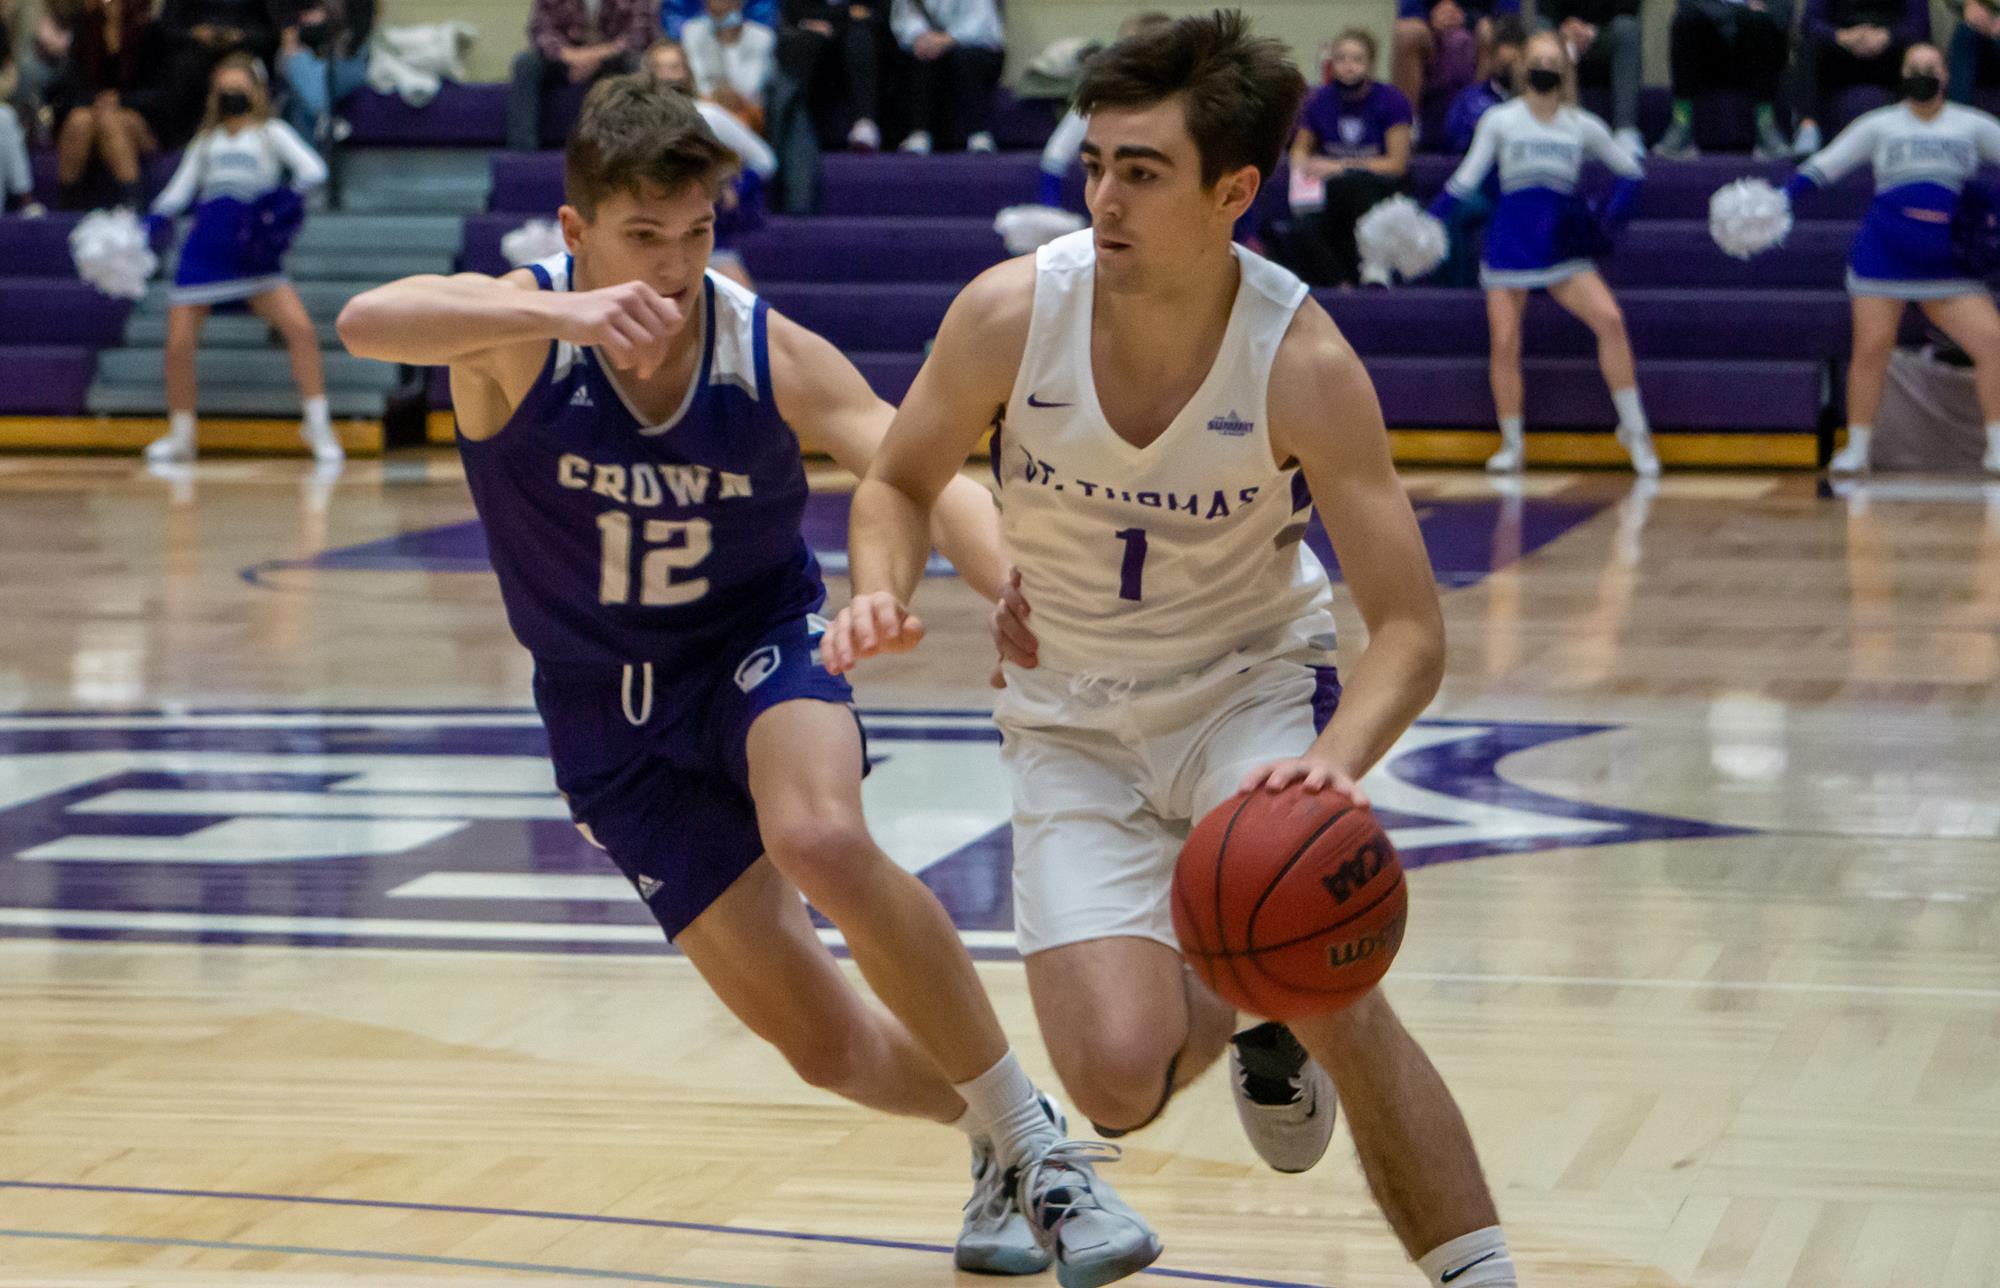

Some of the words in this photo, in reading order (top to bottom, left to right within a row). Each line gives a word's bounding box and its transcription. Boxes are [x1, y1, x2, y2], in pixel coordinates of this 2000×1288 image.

[558, 453, 753, 506] CROWN
[596, 510, 713, 605] 12
[1115, 528, 1148, 601] 1
